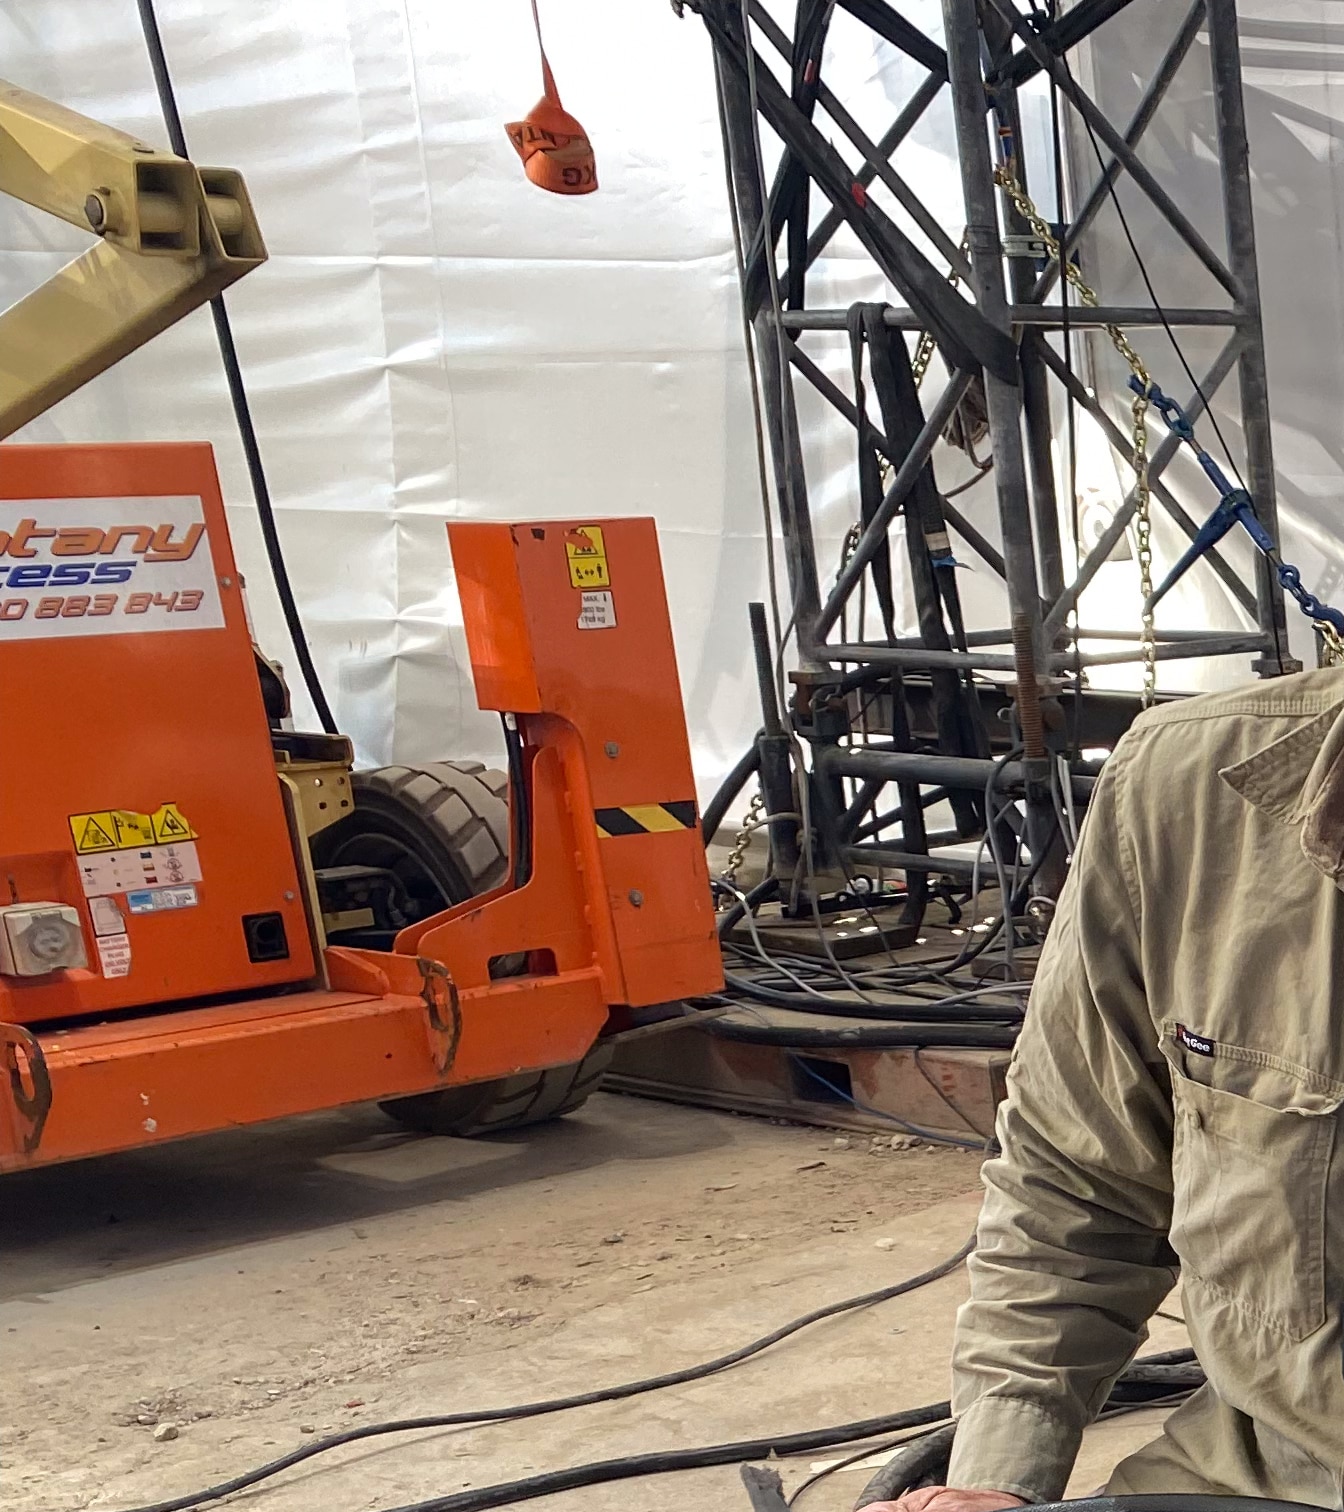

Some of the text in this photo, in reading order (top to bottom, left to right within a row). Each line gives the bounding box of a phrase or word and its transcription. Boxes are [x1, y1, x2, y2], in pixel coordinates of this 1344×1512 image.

[0, 519, 207, 562] tany
[0, 561, 137, 588] ess
[34, 593, 118, 619] 883
[124, 590, 204, 614] 843
